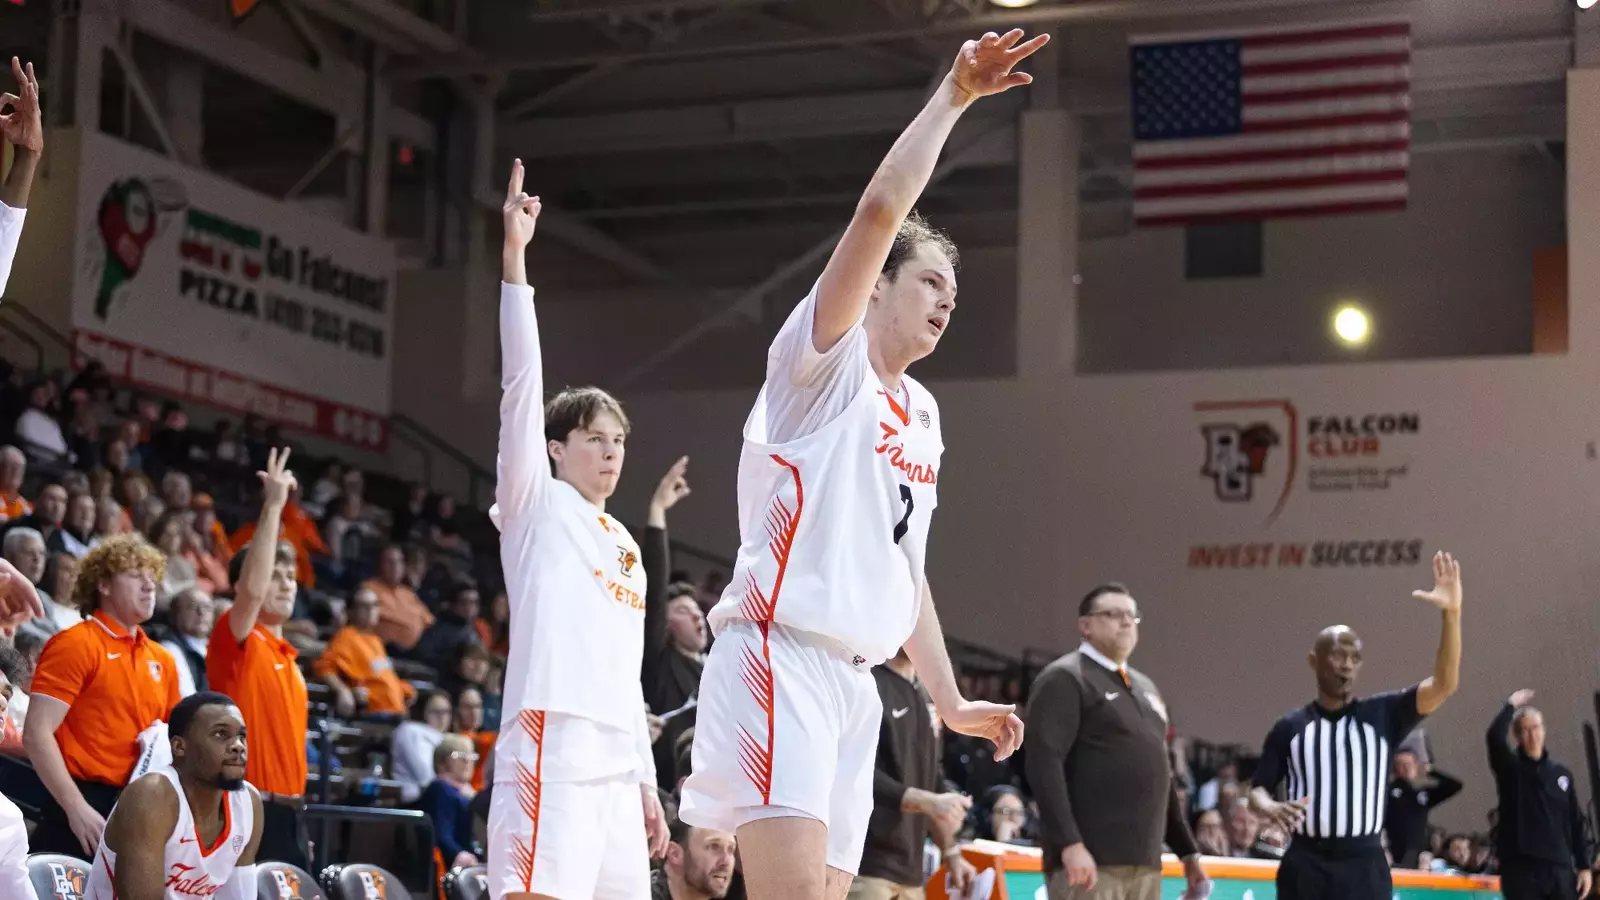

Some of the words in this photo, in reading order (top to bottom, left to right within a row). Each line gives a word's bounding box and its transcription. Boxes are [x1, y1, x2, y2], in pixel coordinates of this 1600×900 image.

[266, 234, 294, 282] Go
[179, 268, 259, 320] PIZZA
[1307, 412, 1420, 435] FALCON
[1308, 436, 1381, 457] CLUB
[893, 483, 915, 545] 7
[1187, 543, 1275, 569] INVEST
[1277, 543, 1306, 567] IN
[1309, 539, 1422, 566] SUCCESS
[165, 863, 224, 896] Falco
